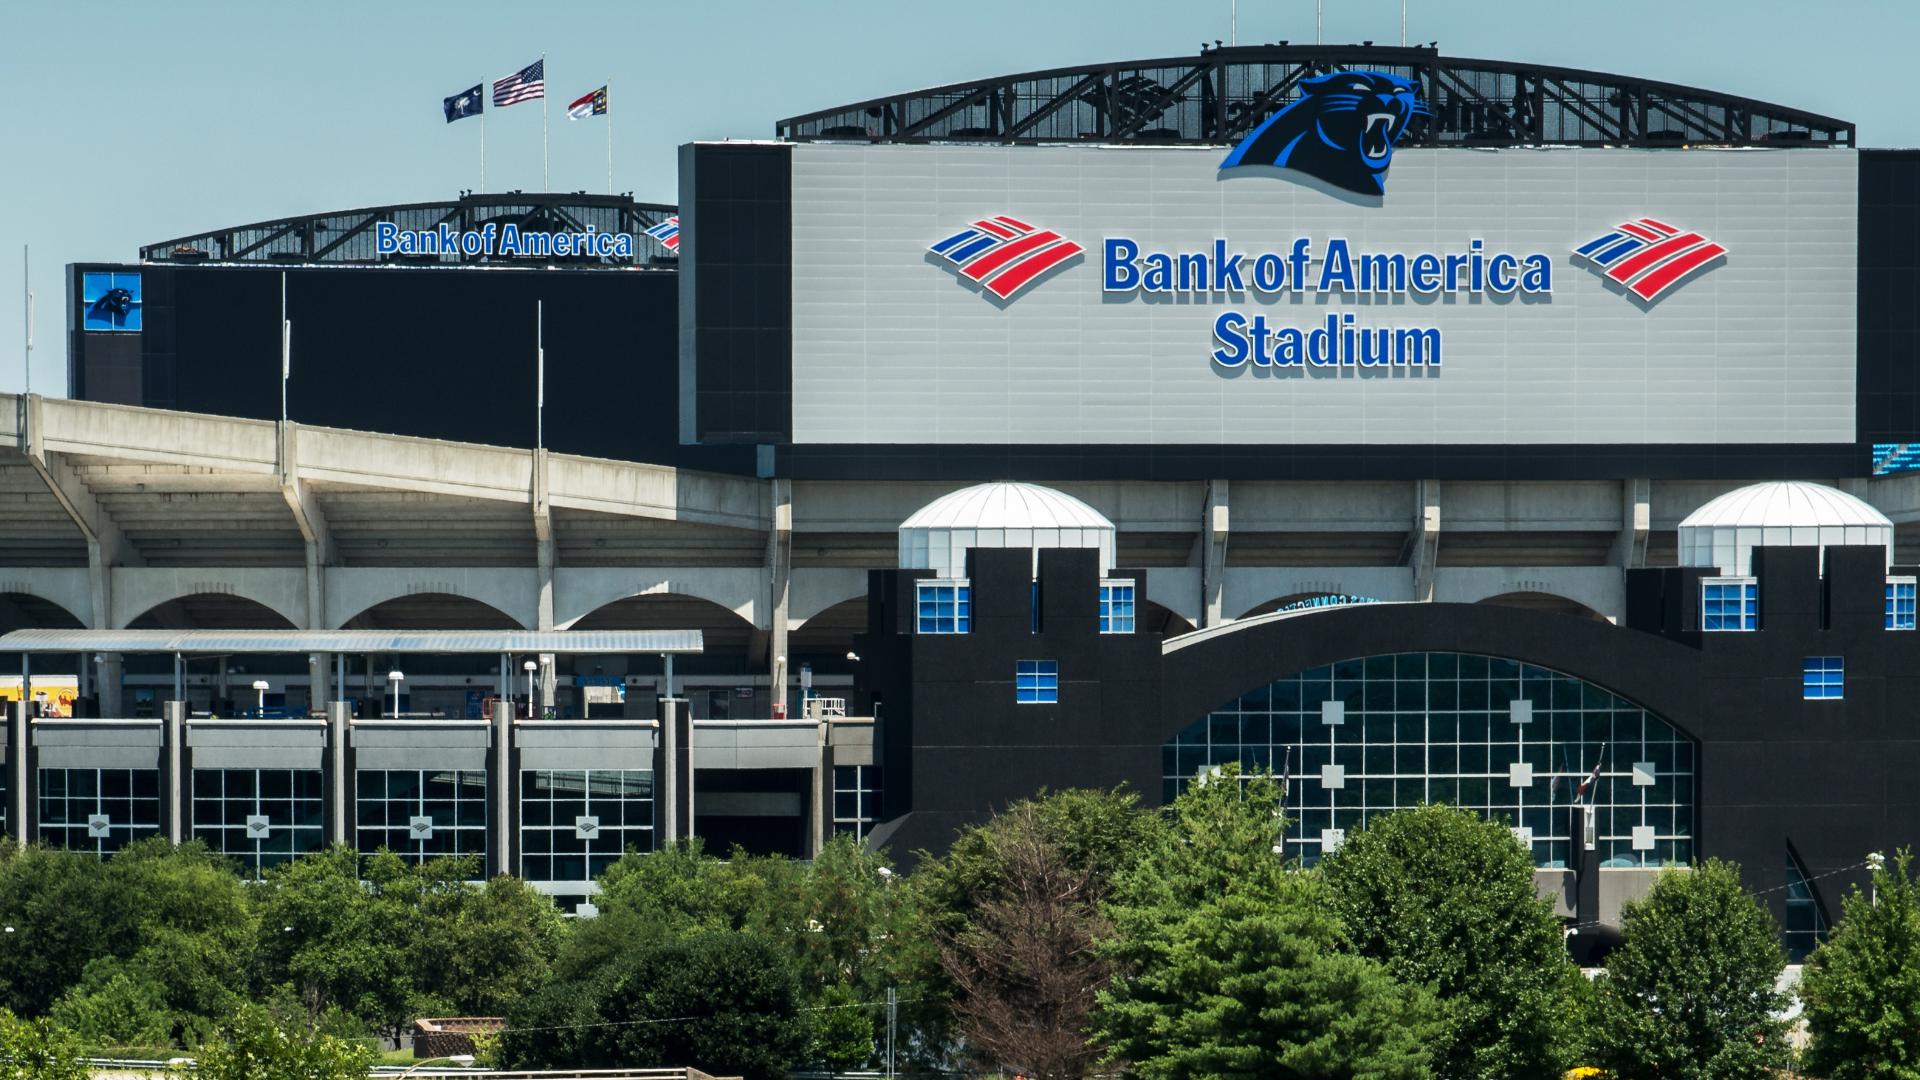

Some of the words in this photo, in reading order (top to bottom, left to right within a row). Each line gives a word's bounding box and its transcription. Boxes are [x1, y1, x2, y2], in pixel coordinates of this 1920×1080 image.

[376, 222, 460, 254] Bank
[462, 222, 496, 255] of
[499, 223, 633, 256] America
[1103, 238, 1245, 293] Bank
[1253, 237, 1311, 293] of
[1318, 238, 1552, 293] America
[1211, 310, 1442, 368] Stadium
